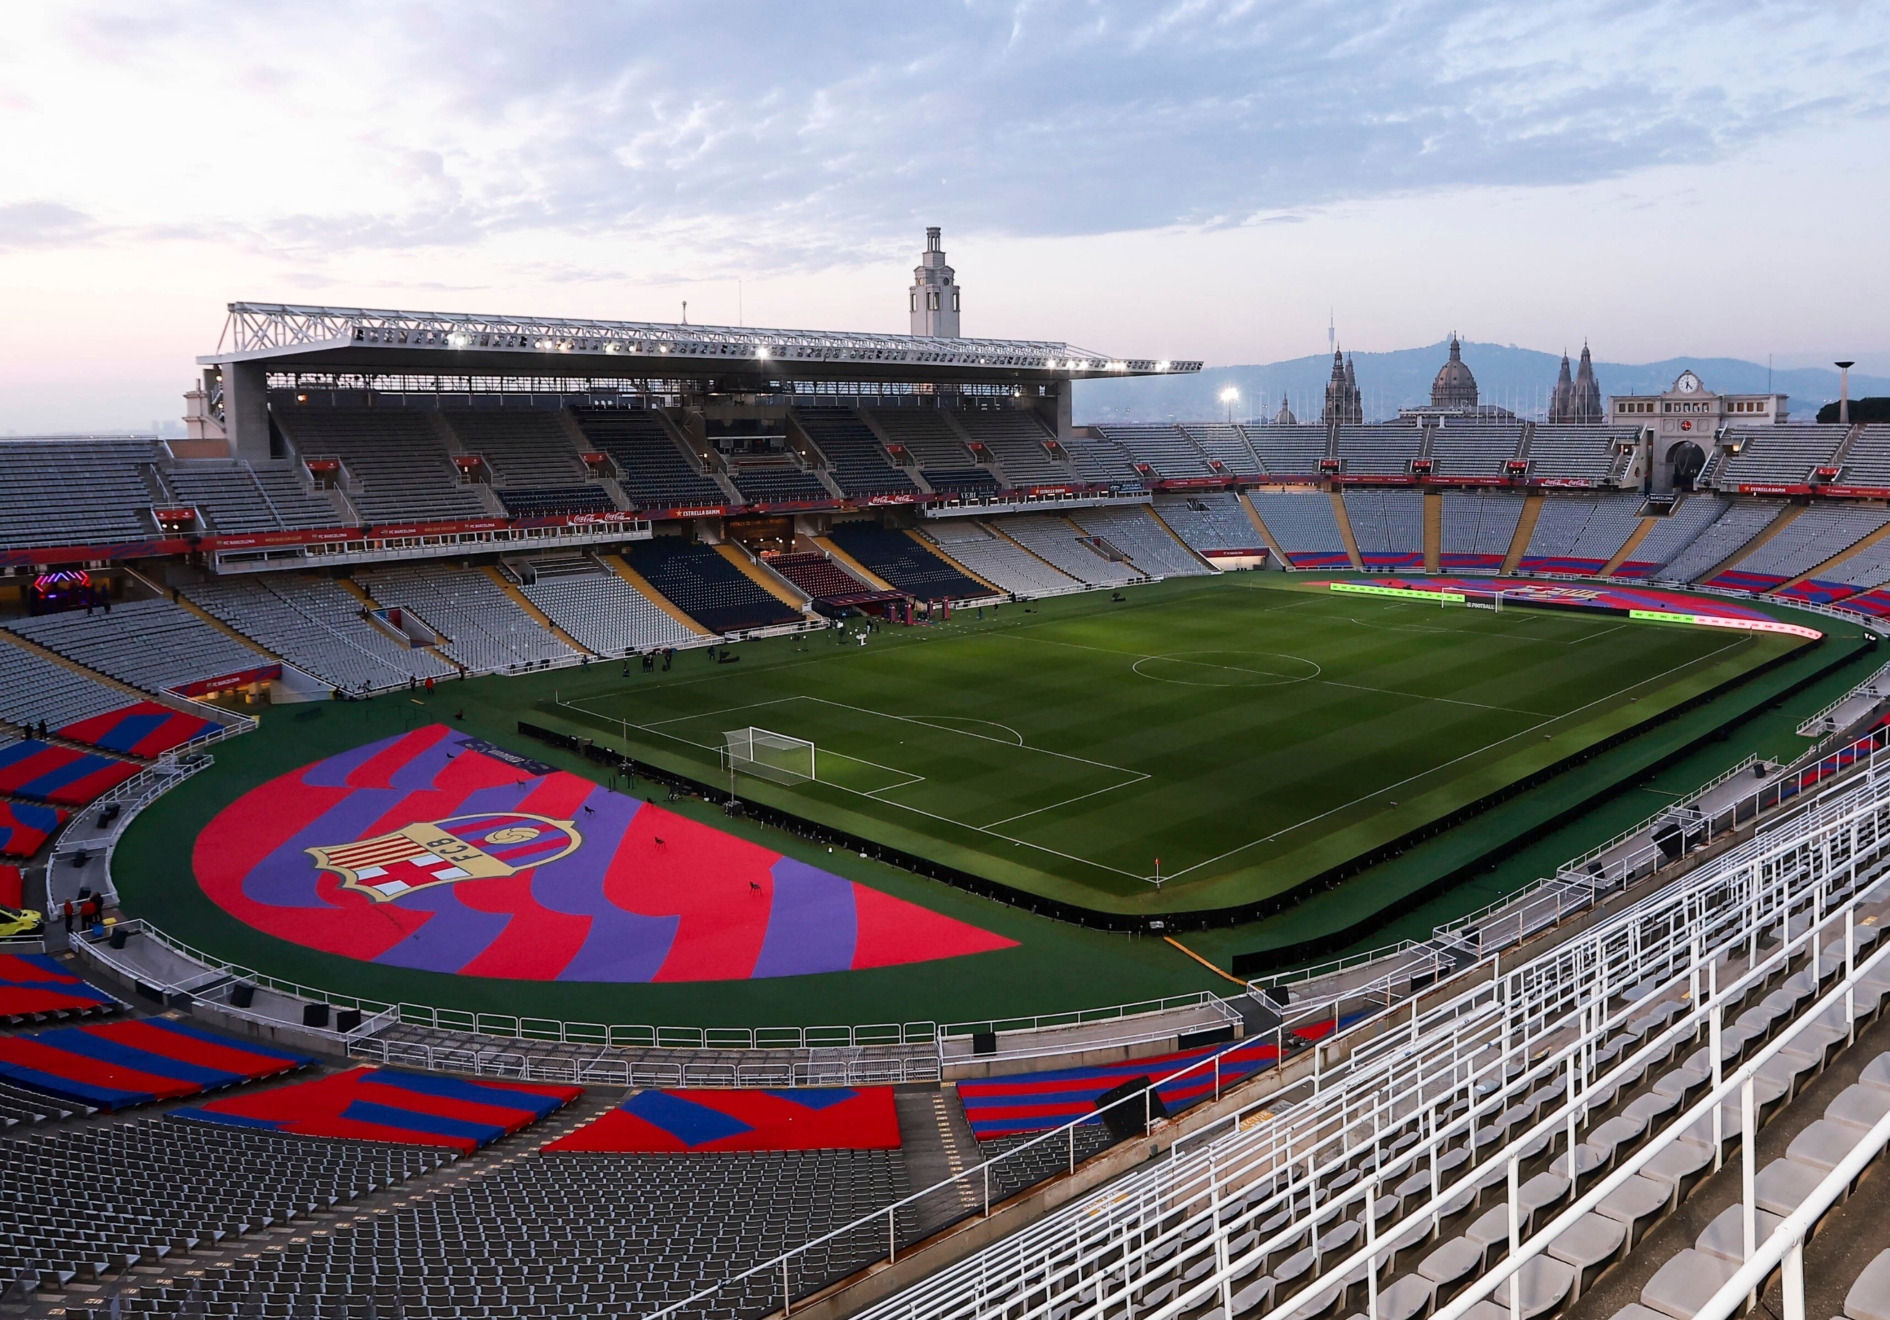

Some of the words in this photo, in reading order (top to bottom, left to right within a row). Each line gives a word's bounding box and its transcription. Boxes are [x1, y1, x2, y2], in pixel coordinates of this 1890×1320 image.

[872, 496, 889, 504] Coca-Cola
[573, 513, 596, 523] Coca-Cola
[604, 511, 626, 521] Coca-Cola
[682, 509, 705, 517] ESTRELLA
[706, 508, 721, 516] DAMM
[217, 677, 240, 686] BARCELONA
[426, 838, 483, 862] FCB
